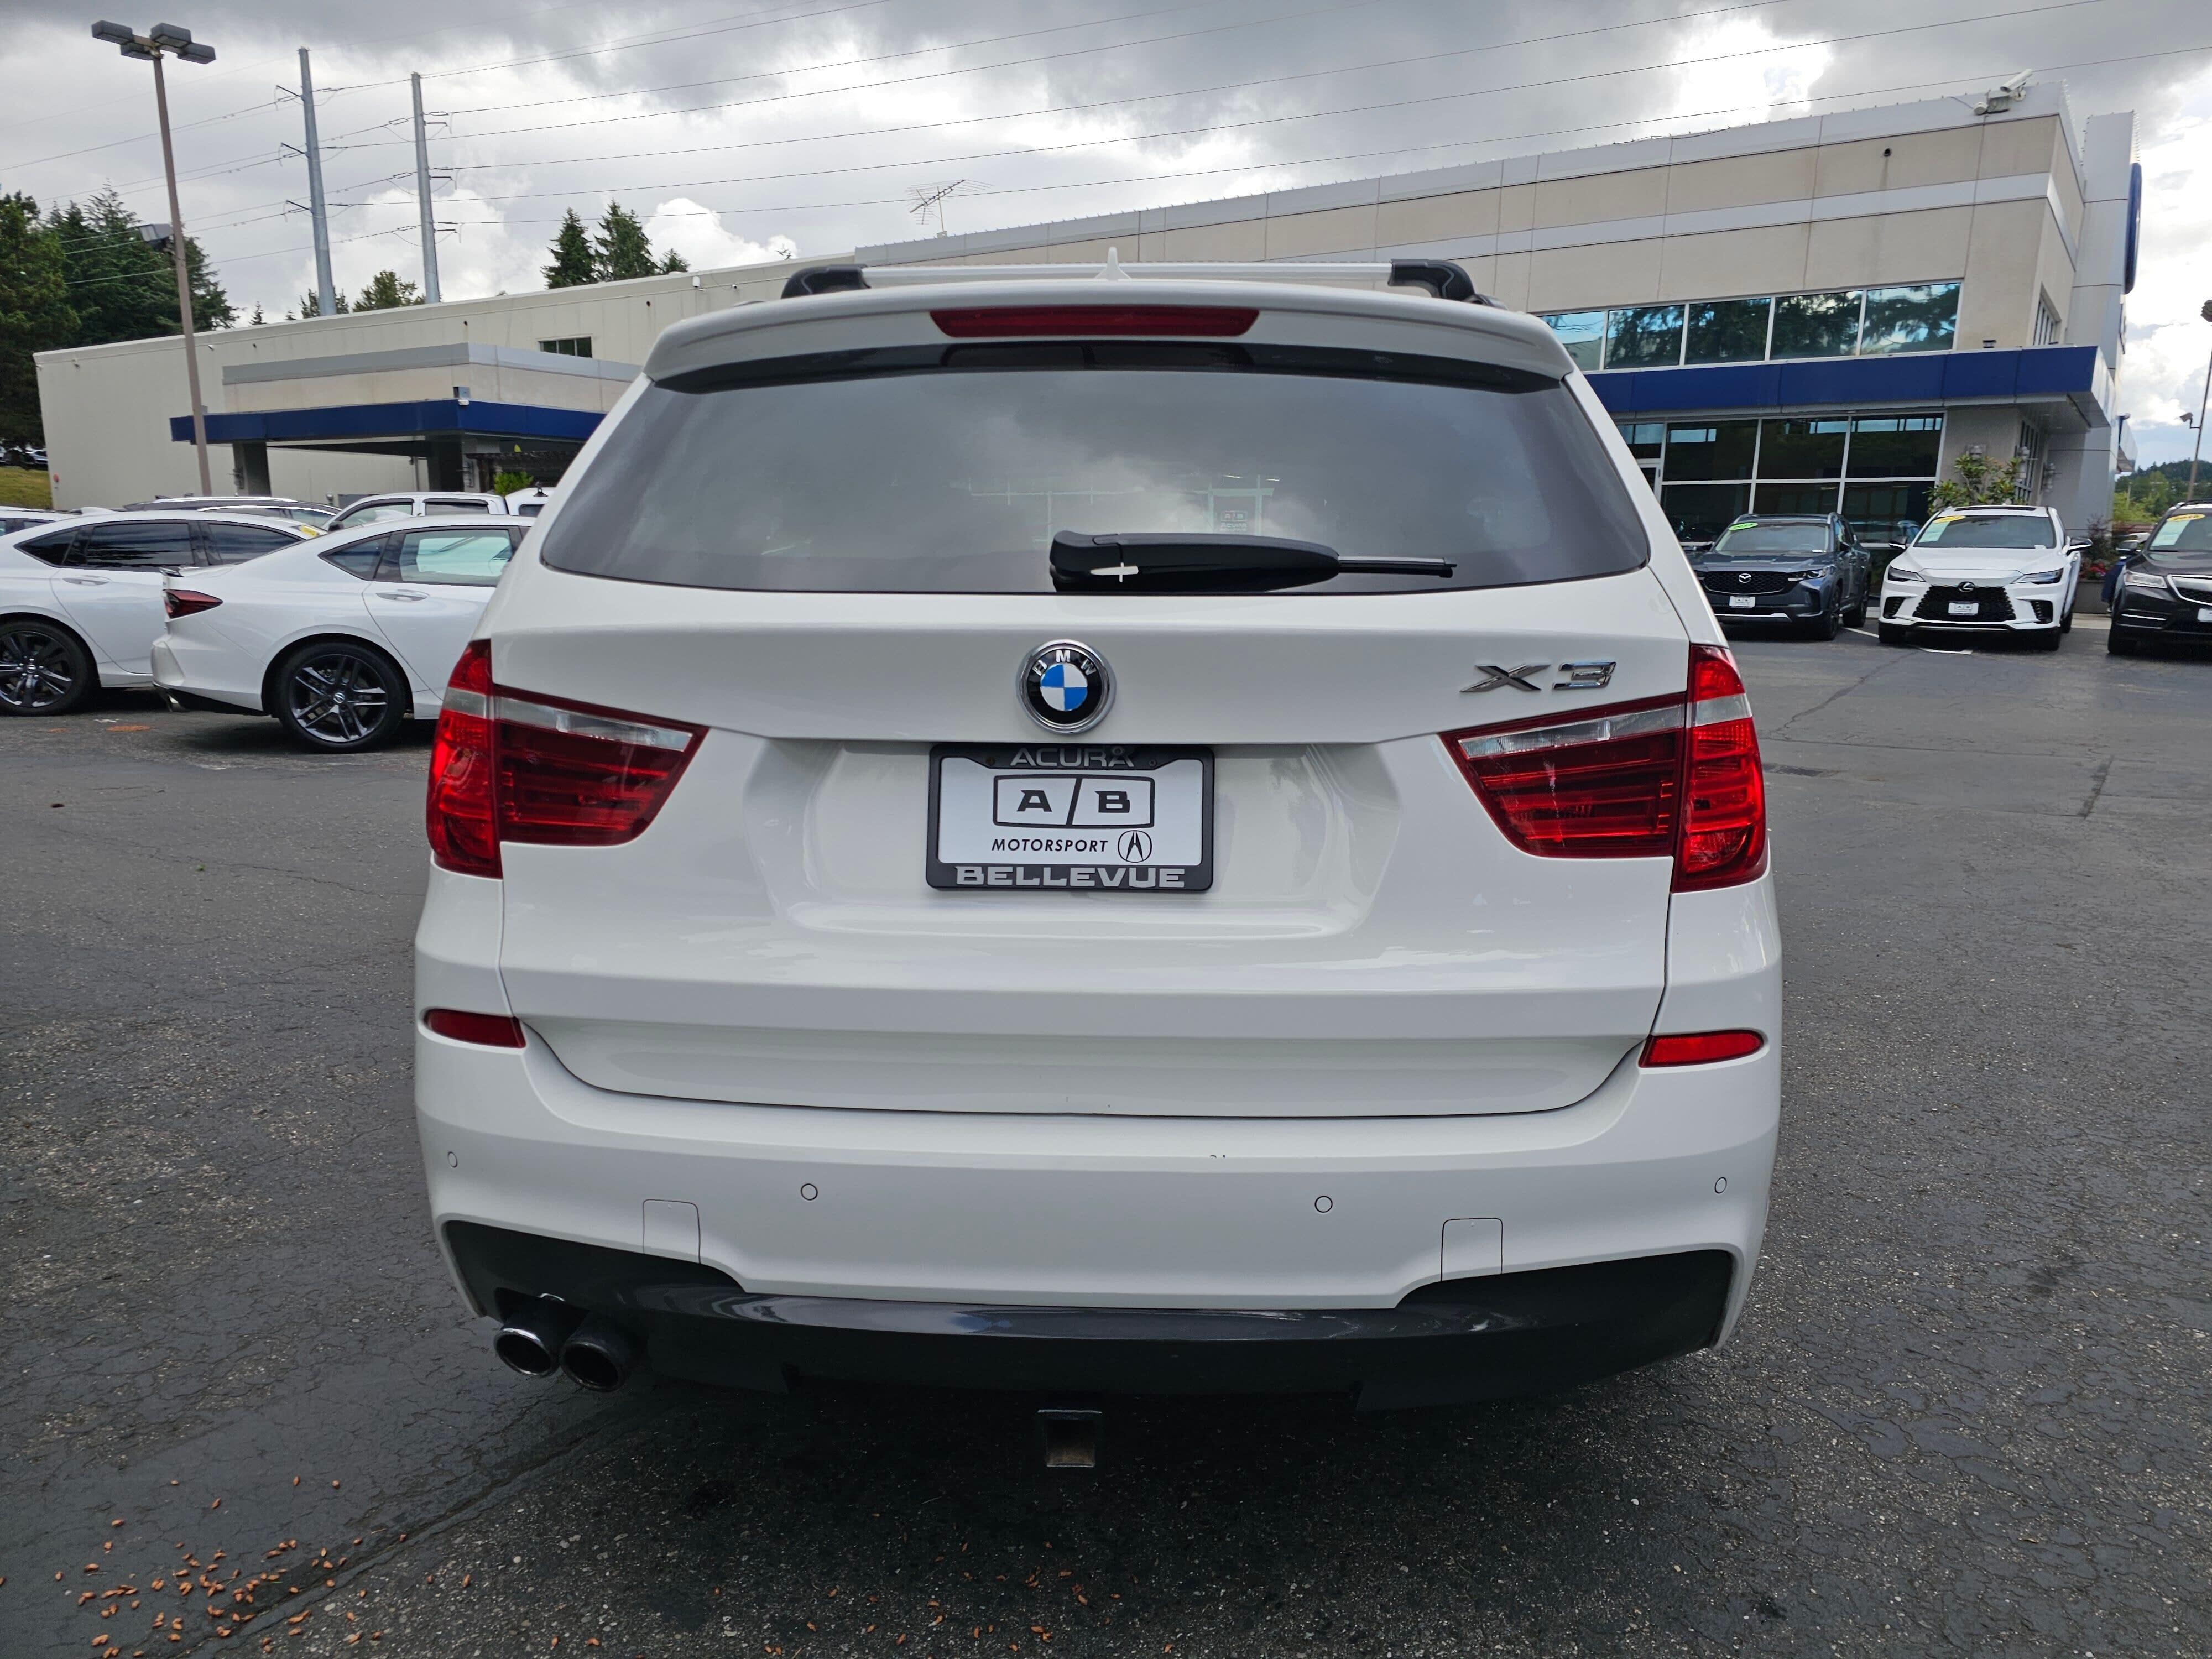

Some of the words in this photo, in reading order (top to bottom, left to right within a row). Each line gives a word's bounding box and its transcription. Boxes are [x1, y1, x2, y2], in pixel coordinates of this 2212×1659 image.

[1032, 649, 1097, 676] BMW
[1459, 662, 1616, 692] X3
[1010, 747, 1134, 767] ACURA
[1016, 790, 1052, 812] A
[1095, 791, 1130, 813] B
[991, 839, 1108, 852] MOTORSPORT
[954, 865, 1185, 888] BELLEVUE
